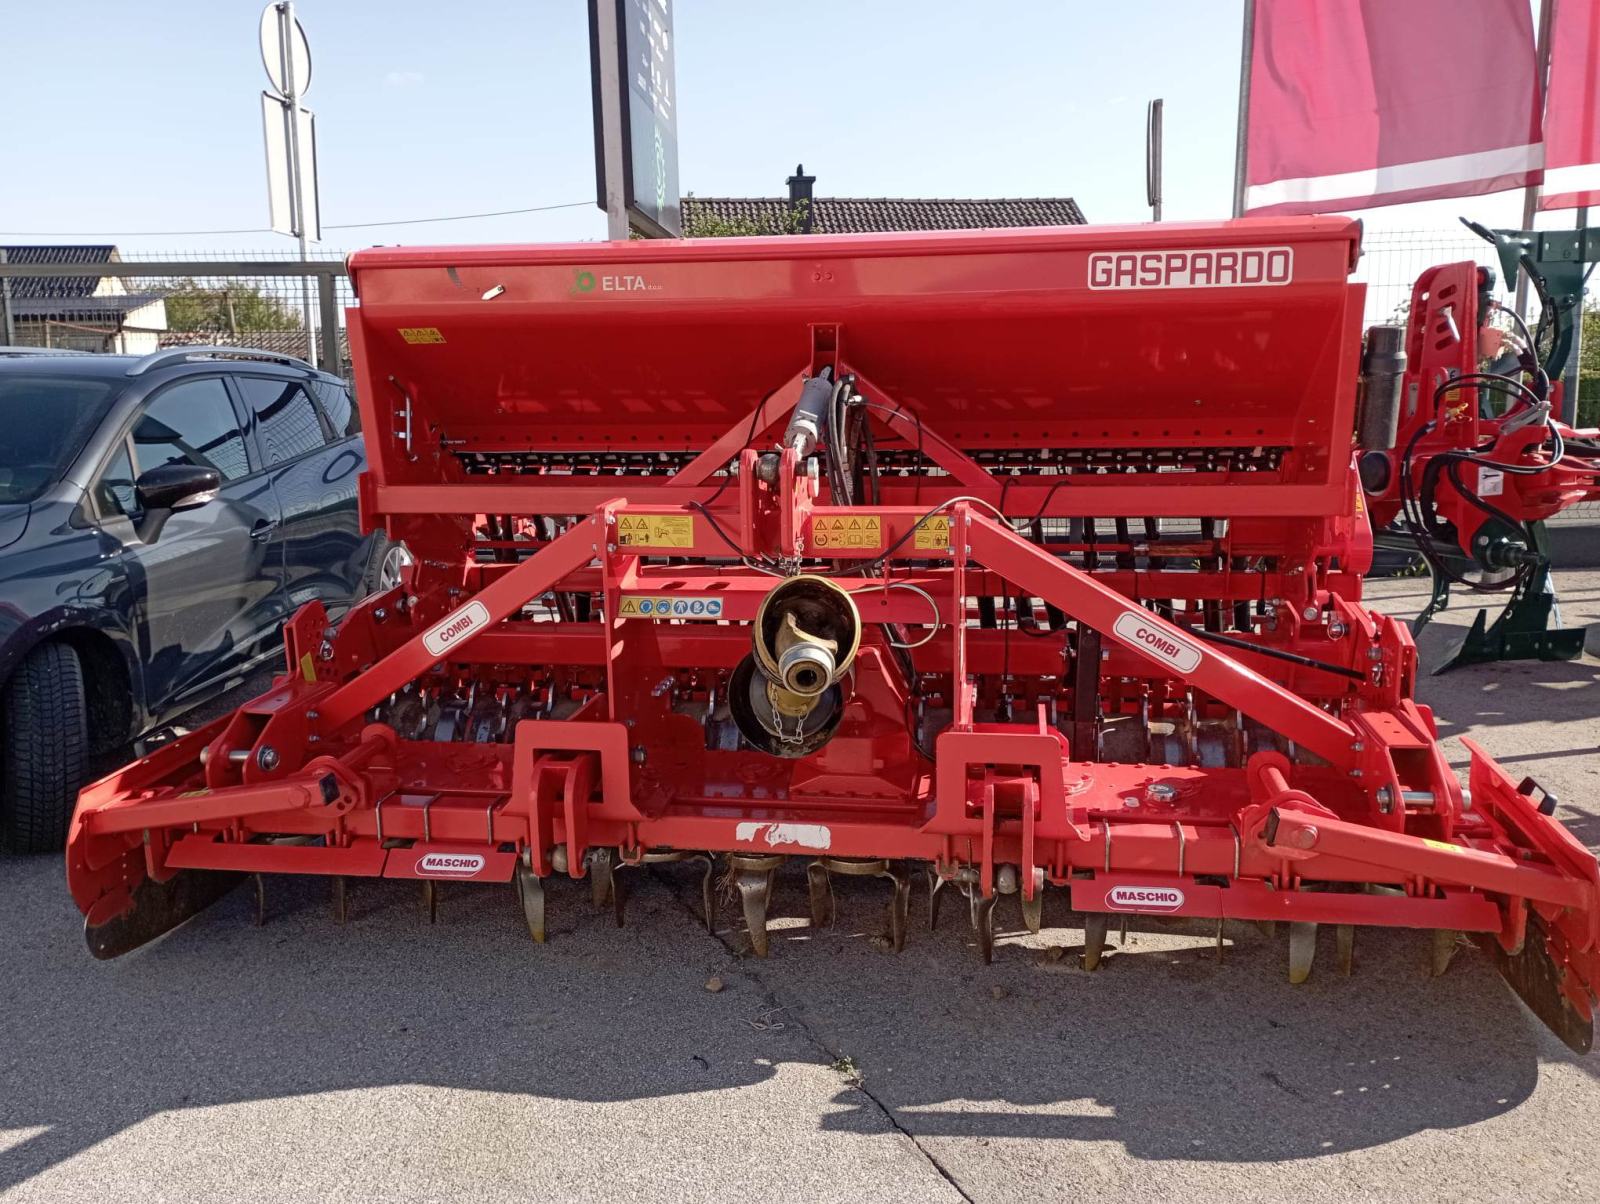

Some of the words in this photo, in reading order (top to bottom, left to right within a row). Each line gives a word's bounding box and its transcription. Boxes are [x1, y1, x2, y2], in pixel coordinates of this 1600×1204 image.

[1090, 249, 1291, 288] GASPARDO
[439, 614, 474, 642] COMBI
[1135, 627, 1182, 659] COMBI
[425, 858, 480, 868] MASCHIO
[1116, 891, 1178, 902] MASCHIO
